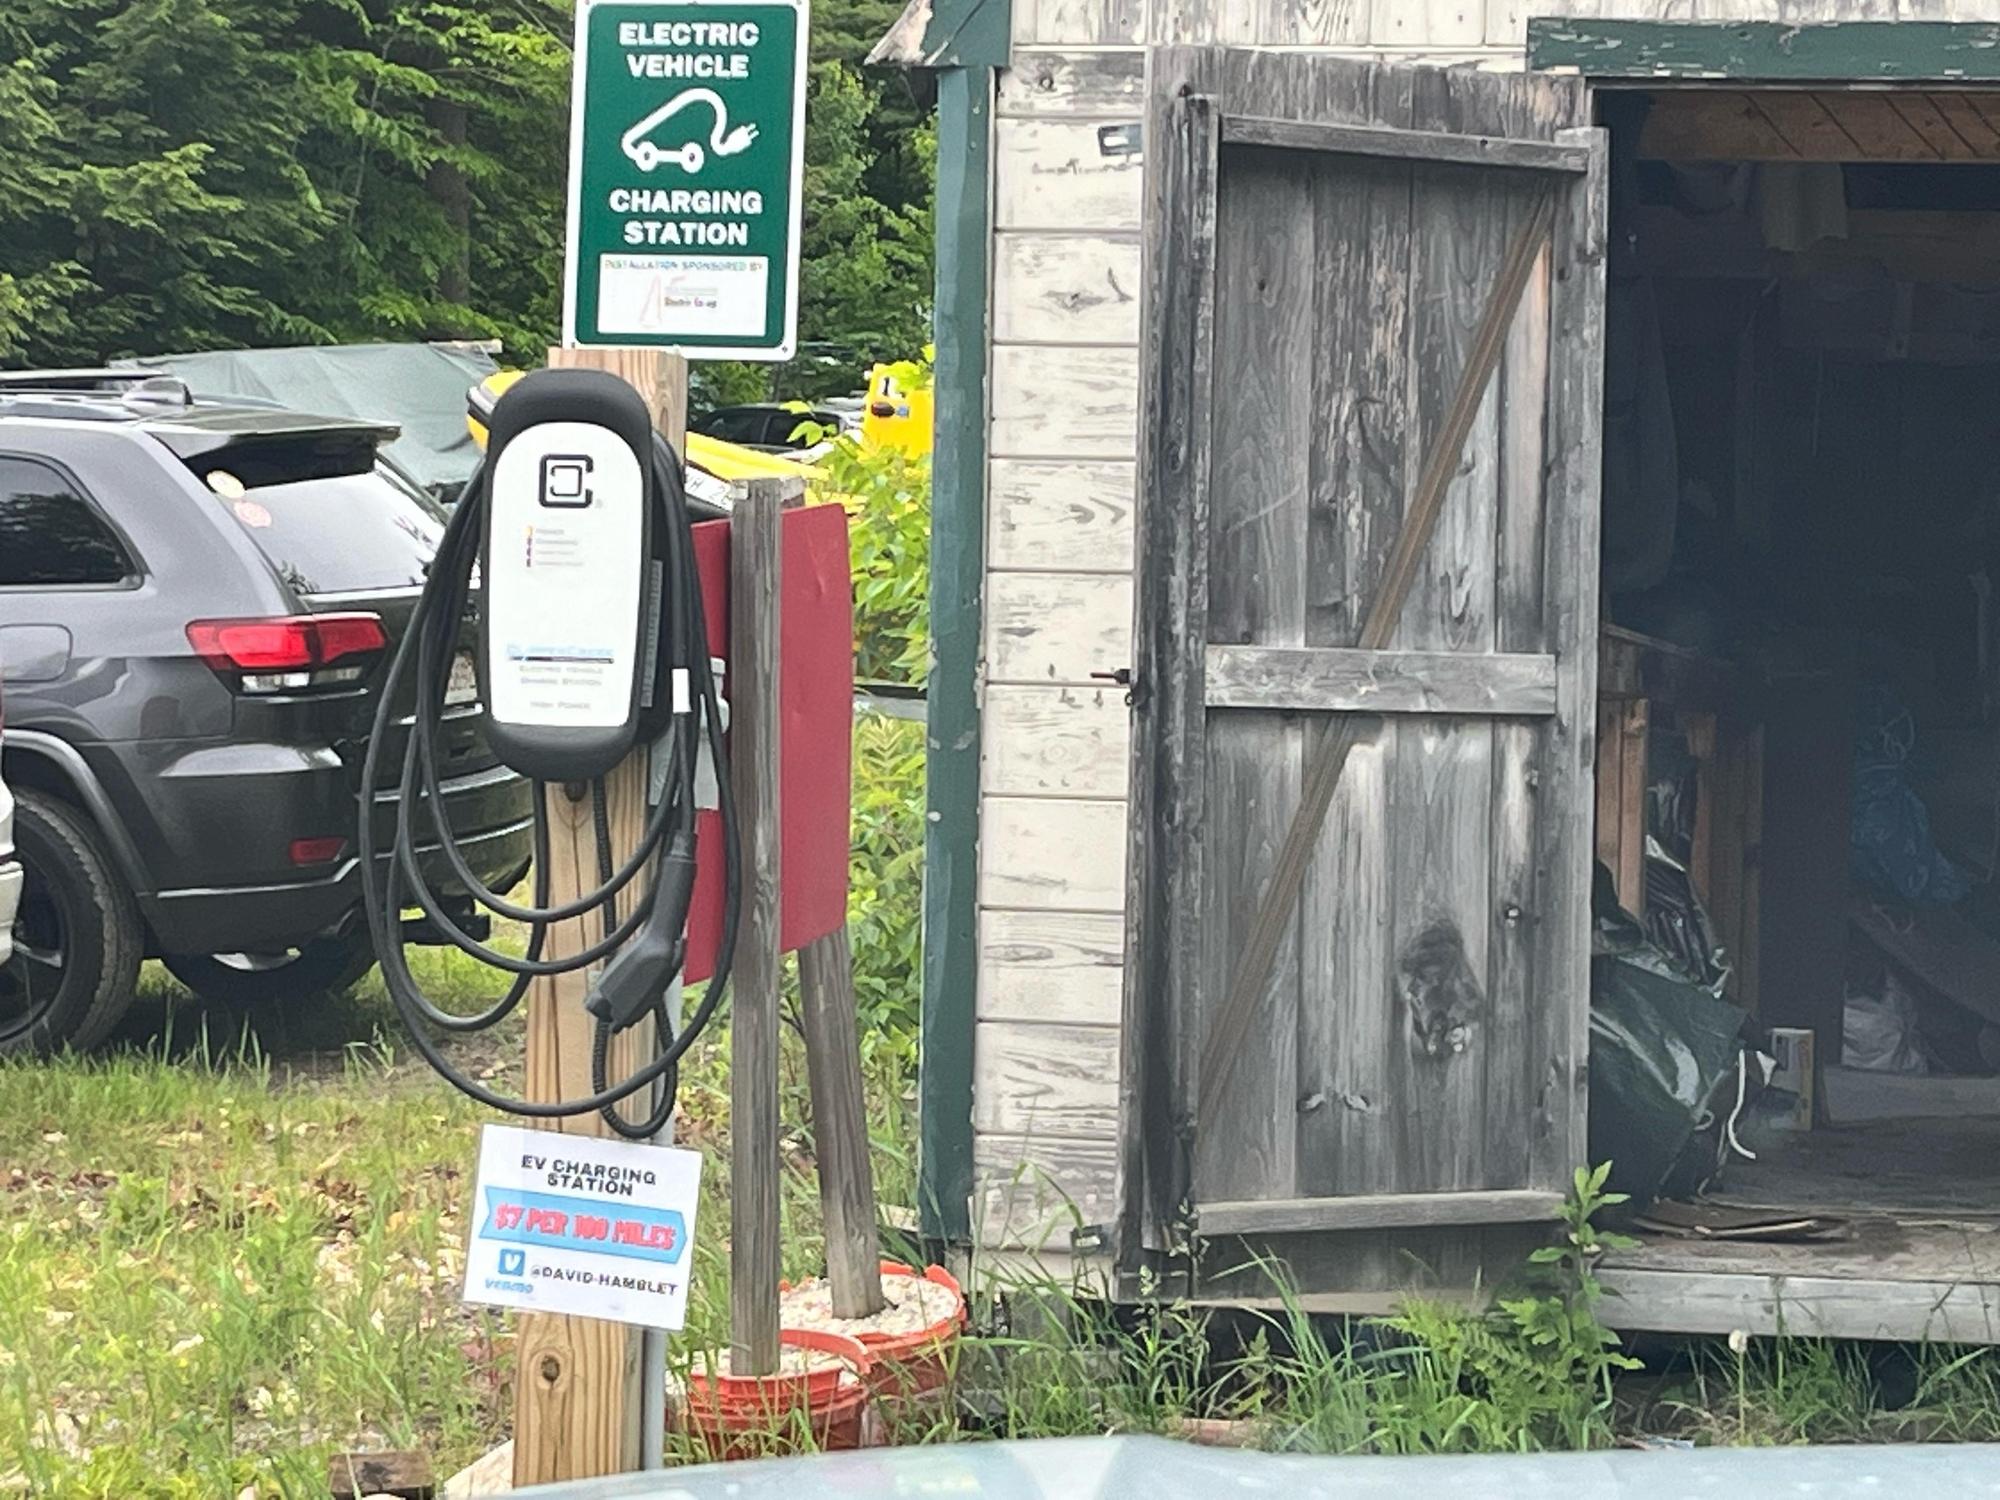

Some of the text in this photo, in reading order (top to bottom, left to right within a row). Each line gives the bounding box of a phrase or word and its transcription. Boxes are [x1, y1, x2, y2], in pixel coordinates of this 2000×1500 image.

[618, 22, 760, 46] ELECTRIC
[626, 54, 750, 78] VEHICLE
[609, 189, 763, 214] CHARGING
[623, 220, 748, 246] STATION
[682, 261, 747, 272] SPONSORED
[521, 1154, 657, 1186] EV CHARGING
[547, 1172, 633, 1196] STATION
[495, 1202, 676, 1250] $7 PER 100 MILES
